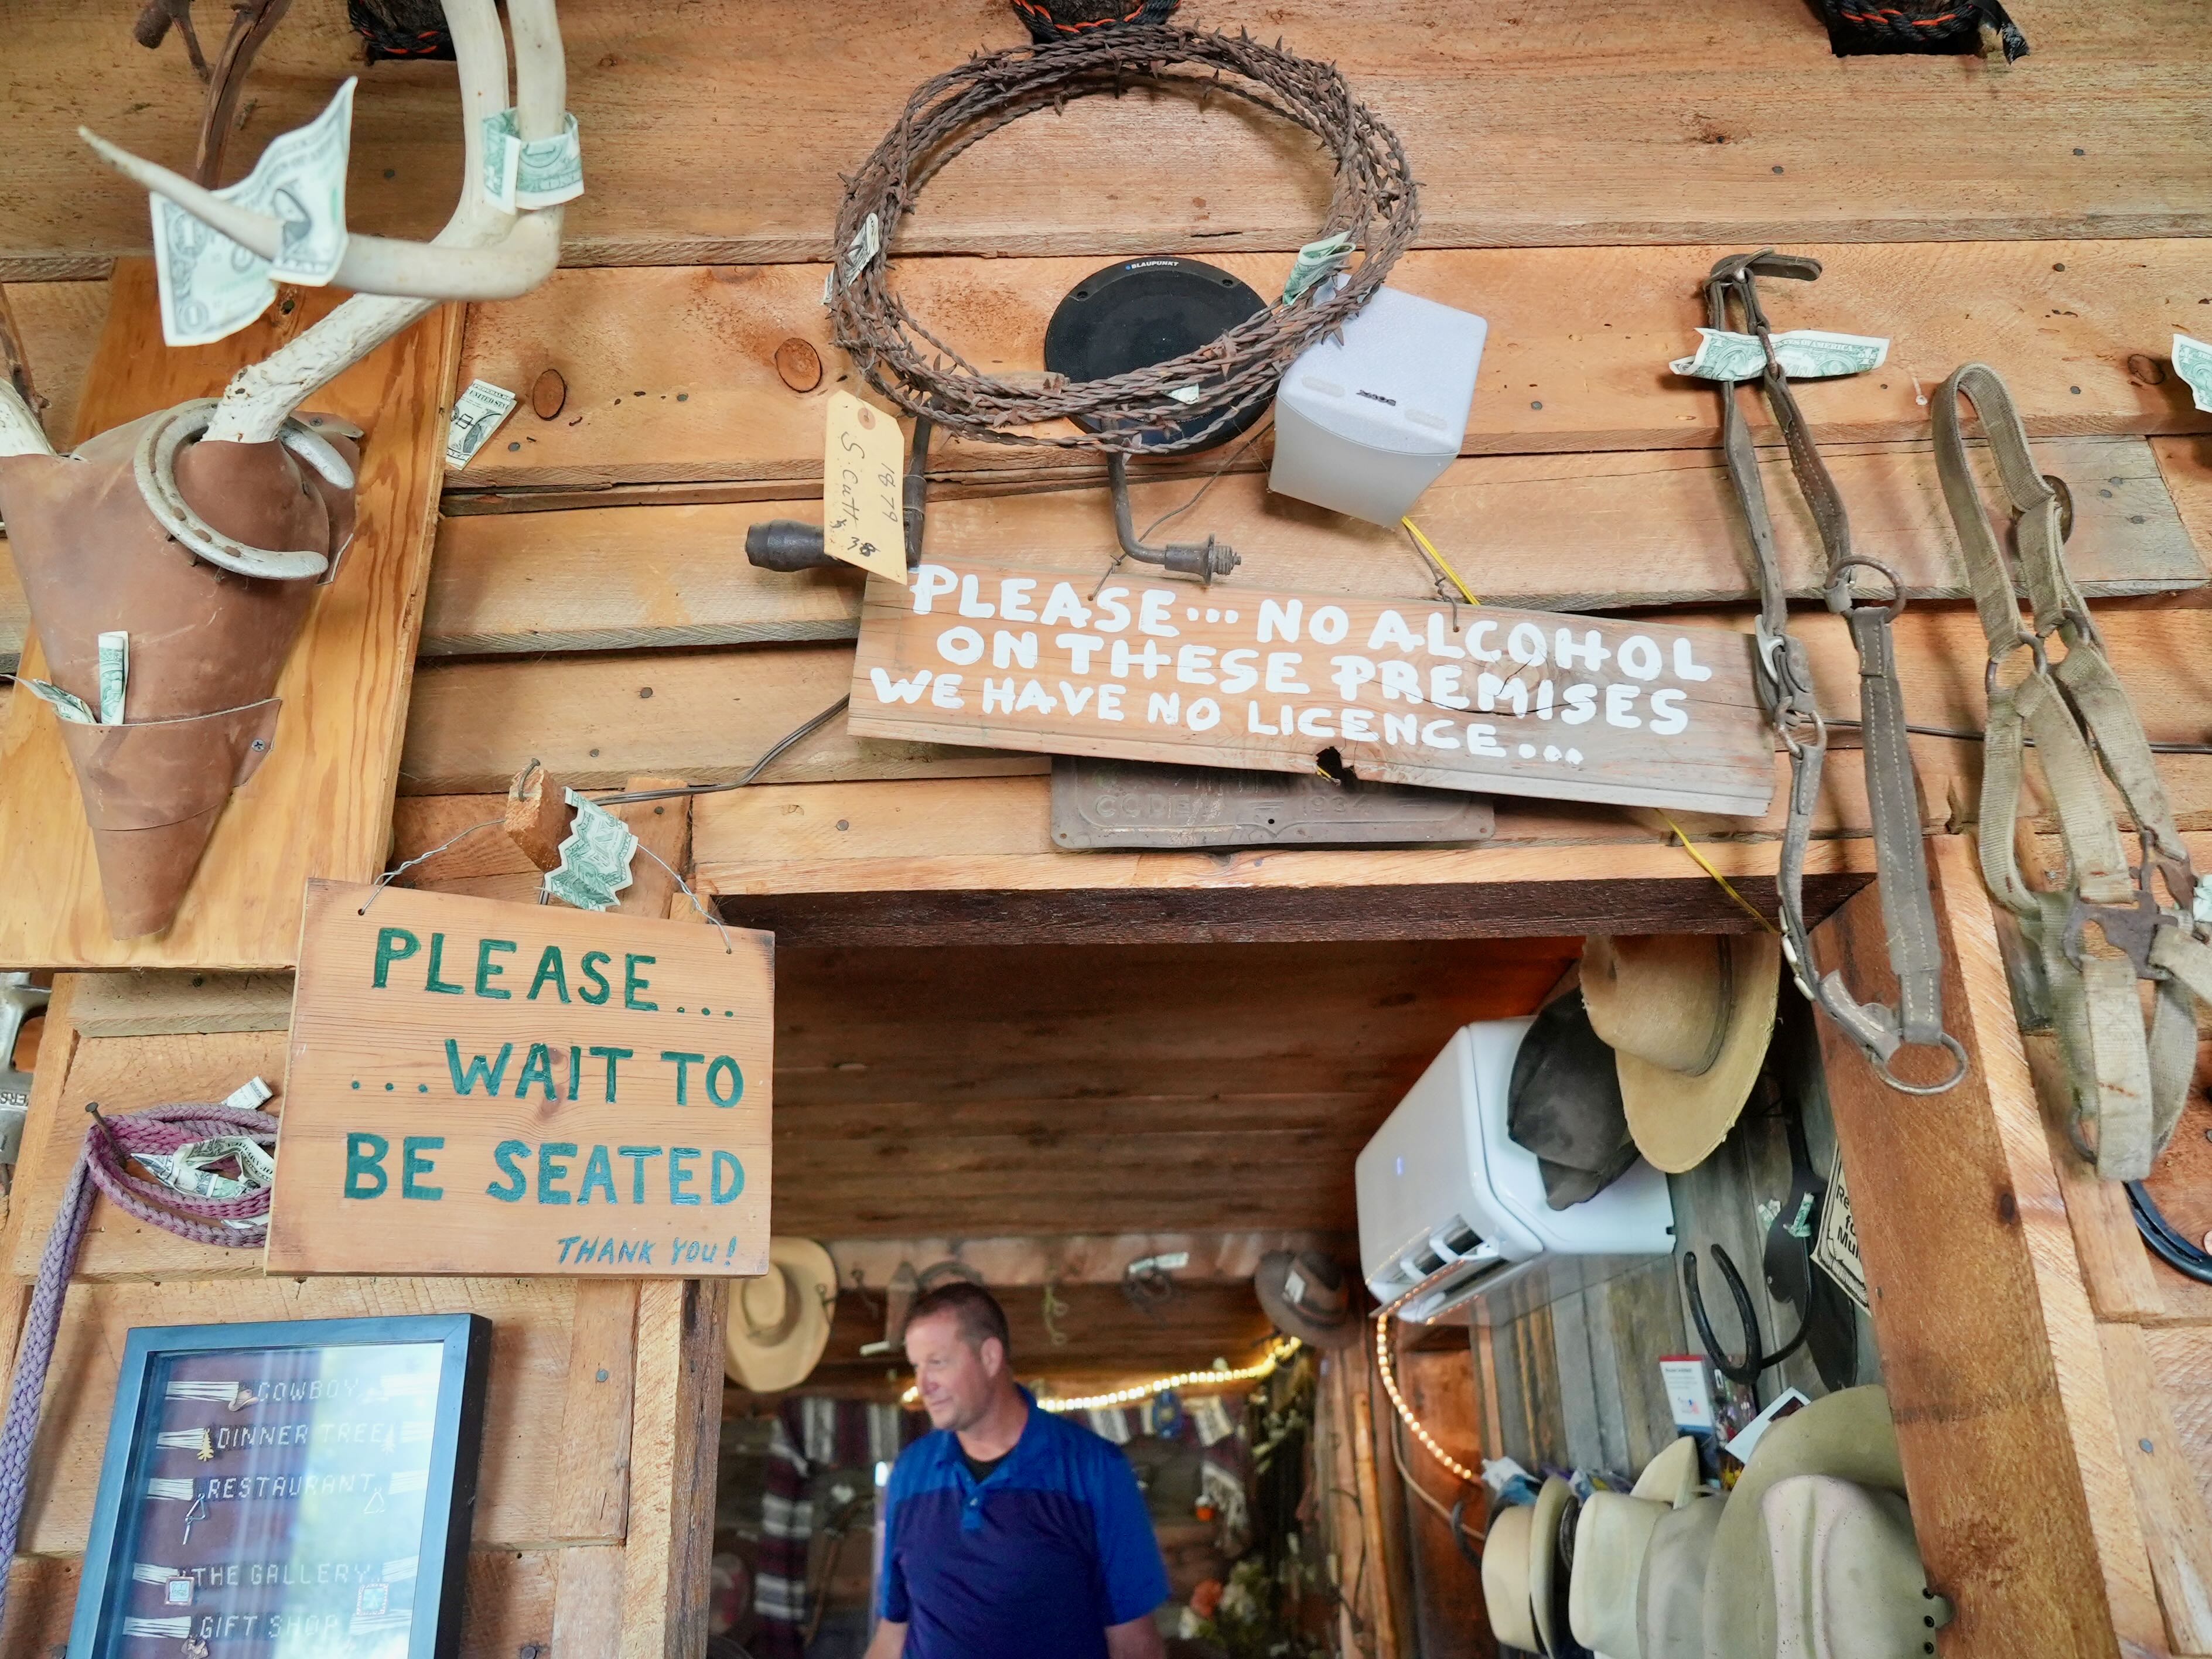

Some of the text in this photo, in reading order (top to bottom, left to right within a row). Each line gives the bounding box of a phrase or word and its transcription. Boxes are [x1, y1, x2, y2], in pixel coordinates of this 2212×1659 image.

[1131, 260, 1179, 269] BLAUPUNKT
[878, 462, 898, 523] 1879
[1256, 598, 1350, 646] NO
[1367, 609, 1713, 682] ALCOHOL
[937, 626, 1689, 736] ON THESE PREMISES
[869, 667, 965, 709] WE
[982, 677, 1127, 722] HAVE
[1147, 691, 1221, 732] NO
[660, 1052, 745, 1108] TO
[344, 1132, 445, 1200] BE
[486, 1139, 746, 1206] SEATED
[557, 1235, 654, 1265] THANK
[257, 1377, 360, 1403] COWBOY
[216, 1421, 385, 1450] DINNER TREE
[207, 1472, 376, 1500] RESTAURANT
[191, 1562, 371, 1587] THE GALLERY
[200, 1613, 339, 1640] GIFT SHOP
